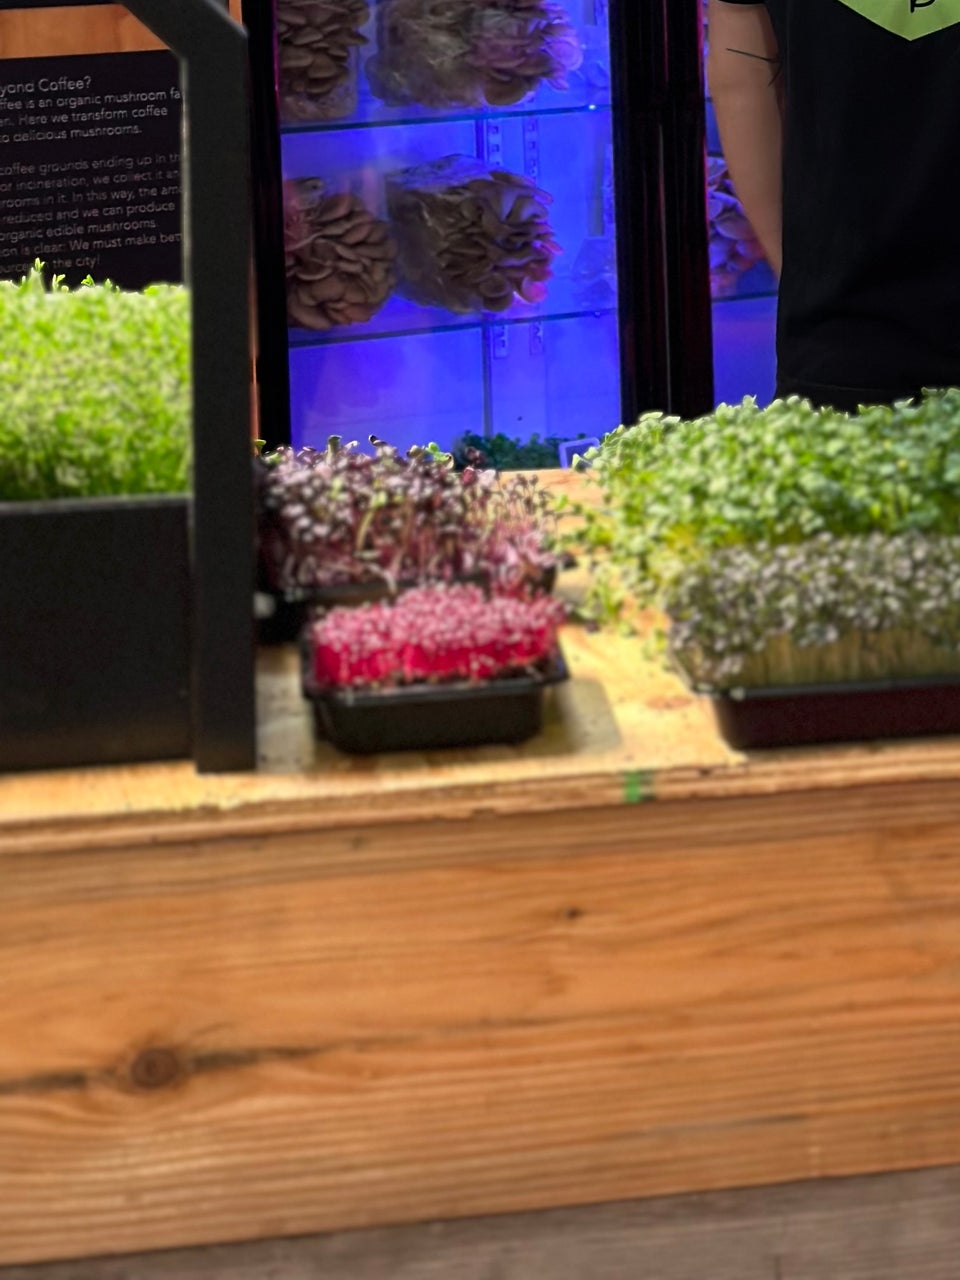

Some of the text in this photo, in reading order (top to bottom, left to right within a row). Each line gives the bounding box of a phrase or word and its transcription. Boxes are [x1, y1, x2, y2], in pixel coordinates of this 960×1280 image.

[39, 75, 92, 92] Coffee?
[39, 99, 53, 108] an
[56, 95, 101, 109] organic
[104, 91, 167, 103] mushroom
[51, 114, 69, 123] we
[71, 108, 127, 122] transform
[131, 104, 168, 118] coffee
[13, 129, 67, 142] delicious
[70, 125, 142, 139] mushrooms.
[40, 160, 89, 176] grounds
[91, 156, 133, 169] ending
[137, 156, 152, 167] up
[156, 154, 166, 163] in
[93, 175, 110, 184] we
[113, 171, 152, 183] collect
[86, 189, 107, 201] this
[111, 190, 135, 201] way,
[138, 186, 157, 197] the
[56, 208, 79, 220] and
[82, 208, 99, 217] we
[102, 206, 123, 216] can
[126, 201, 175, 217] produce
[46, 224, 84, 237] edible
[69, 239, 89, 251] We
[93, 237, 121, 248] must
[125, 234, 157, 245] make
